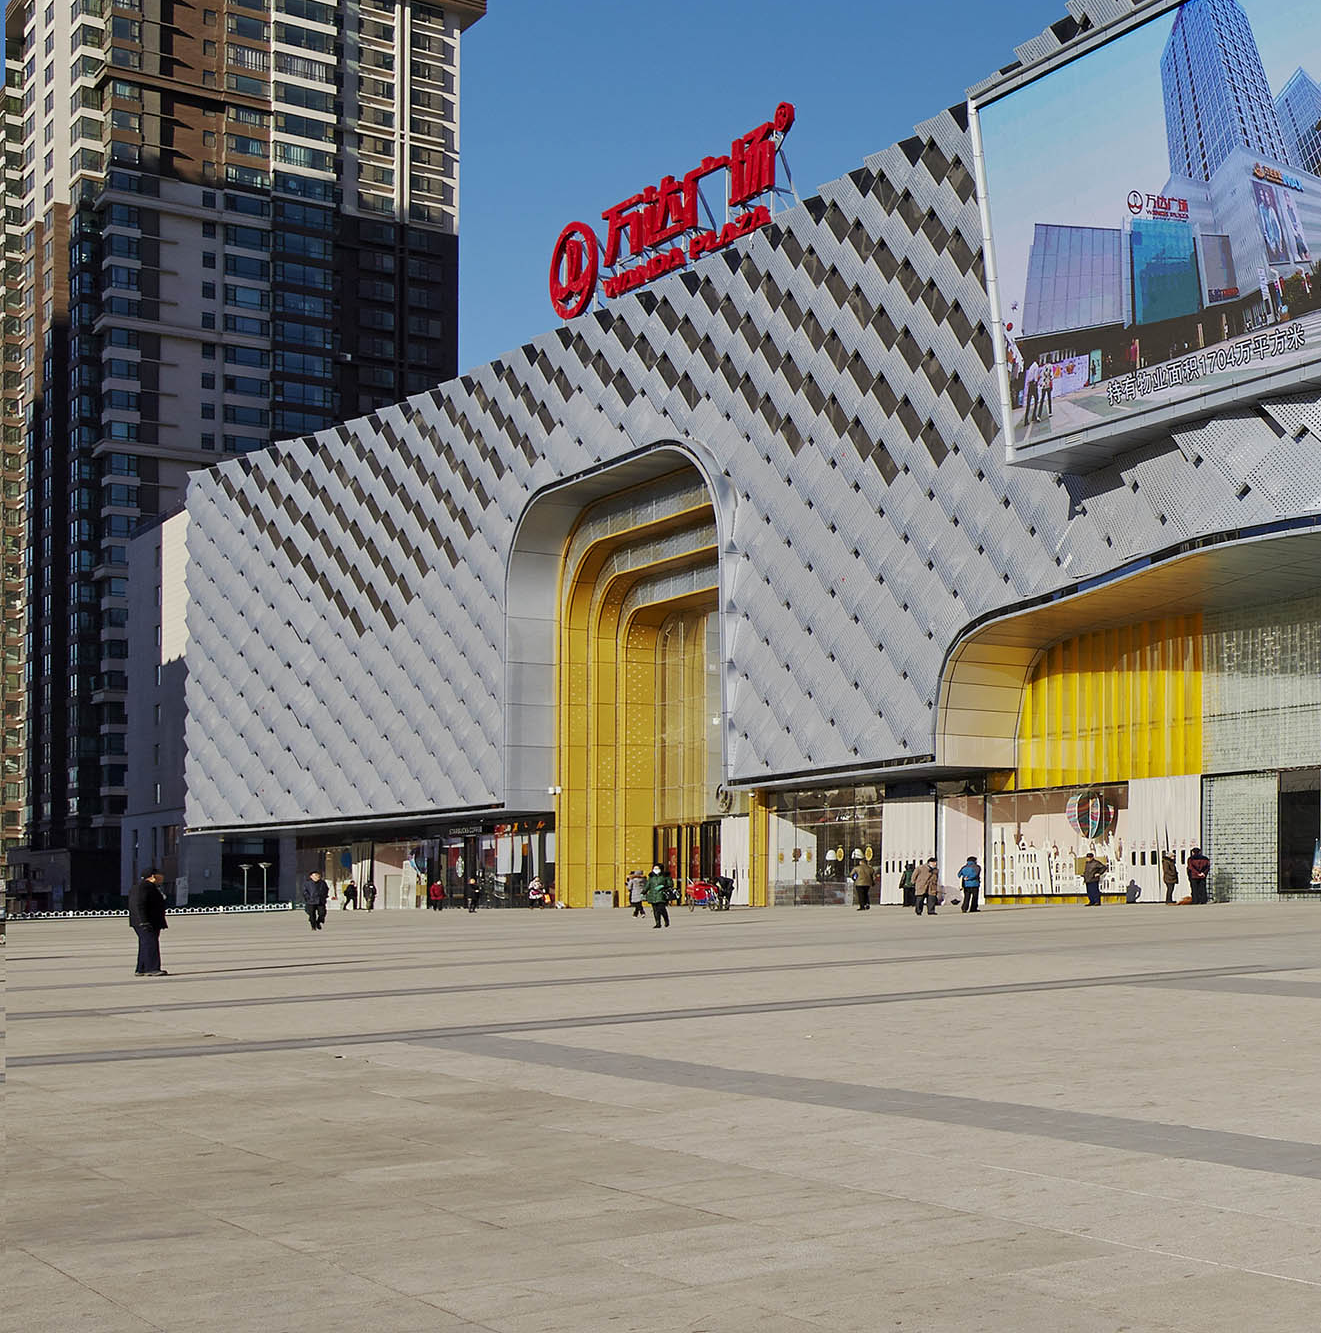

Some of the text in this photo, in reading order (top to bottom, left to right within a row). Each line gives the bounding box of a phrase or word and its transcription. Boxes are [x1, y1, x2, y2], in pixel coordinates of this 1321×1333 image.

[602, 121, 776, 268] 万达广场
[602, 205, 772, 299] WANDA PLAZA
[1106, 322, 1306, 407] 持有物业面积1704万平方米
